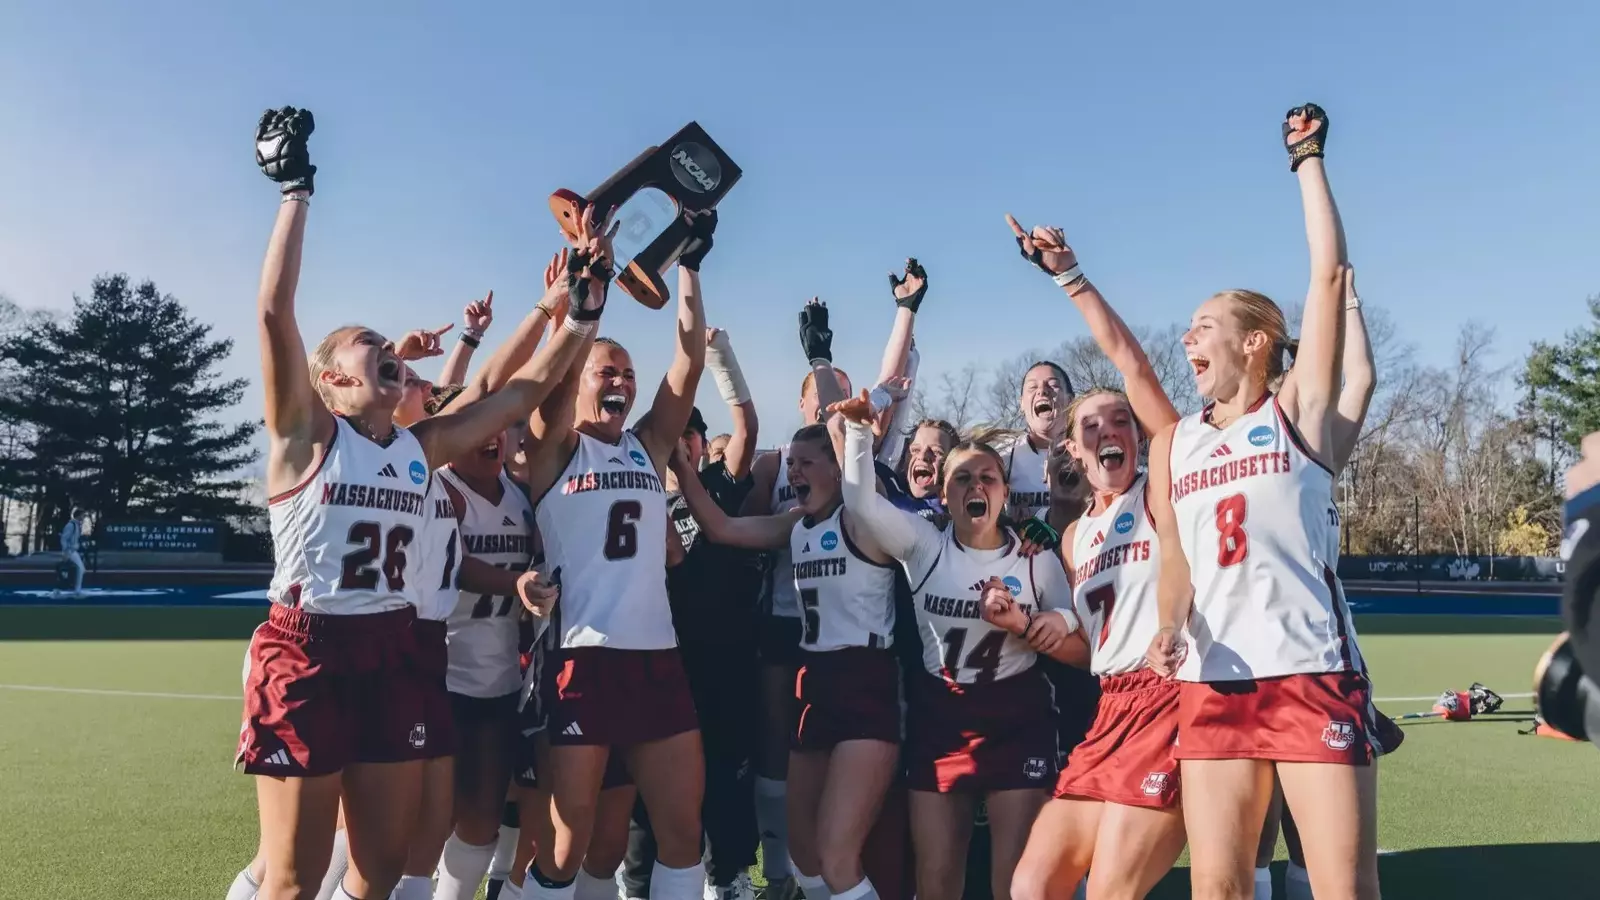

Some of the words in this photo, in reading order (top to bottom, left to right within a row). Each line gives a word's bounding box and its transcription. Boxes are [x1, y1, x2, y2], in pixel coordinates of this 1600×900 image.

[672, 150, 715, 191] NCAA
[1250, 433, 1273, 442] NCAA
[1173, 451, 1291, 503] MASSACHUSETTS
[603, 499, 643, 561] 6
[1117, 522, 1133, 530] NCAA
[1214, 492, 1248, 568] 8
[339, 520, 414, 593] 26
[800, 587, 820, 645] 5
[1085, 581, 1116, 652] 7
[943, 626, 1008, 685] 14
